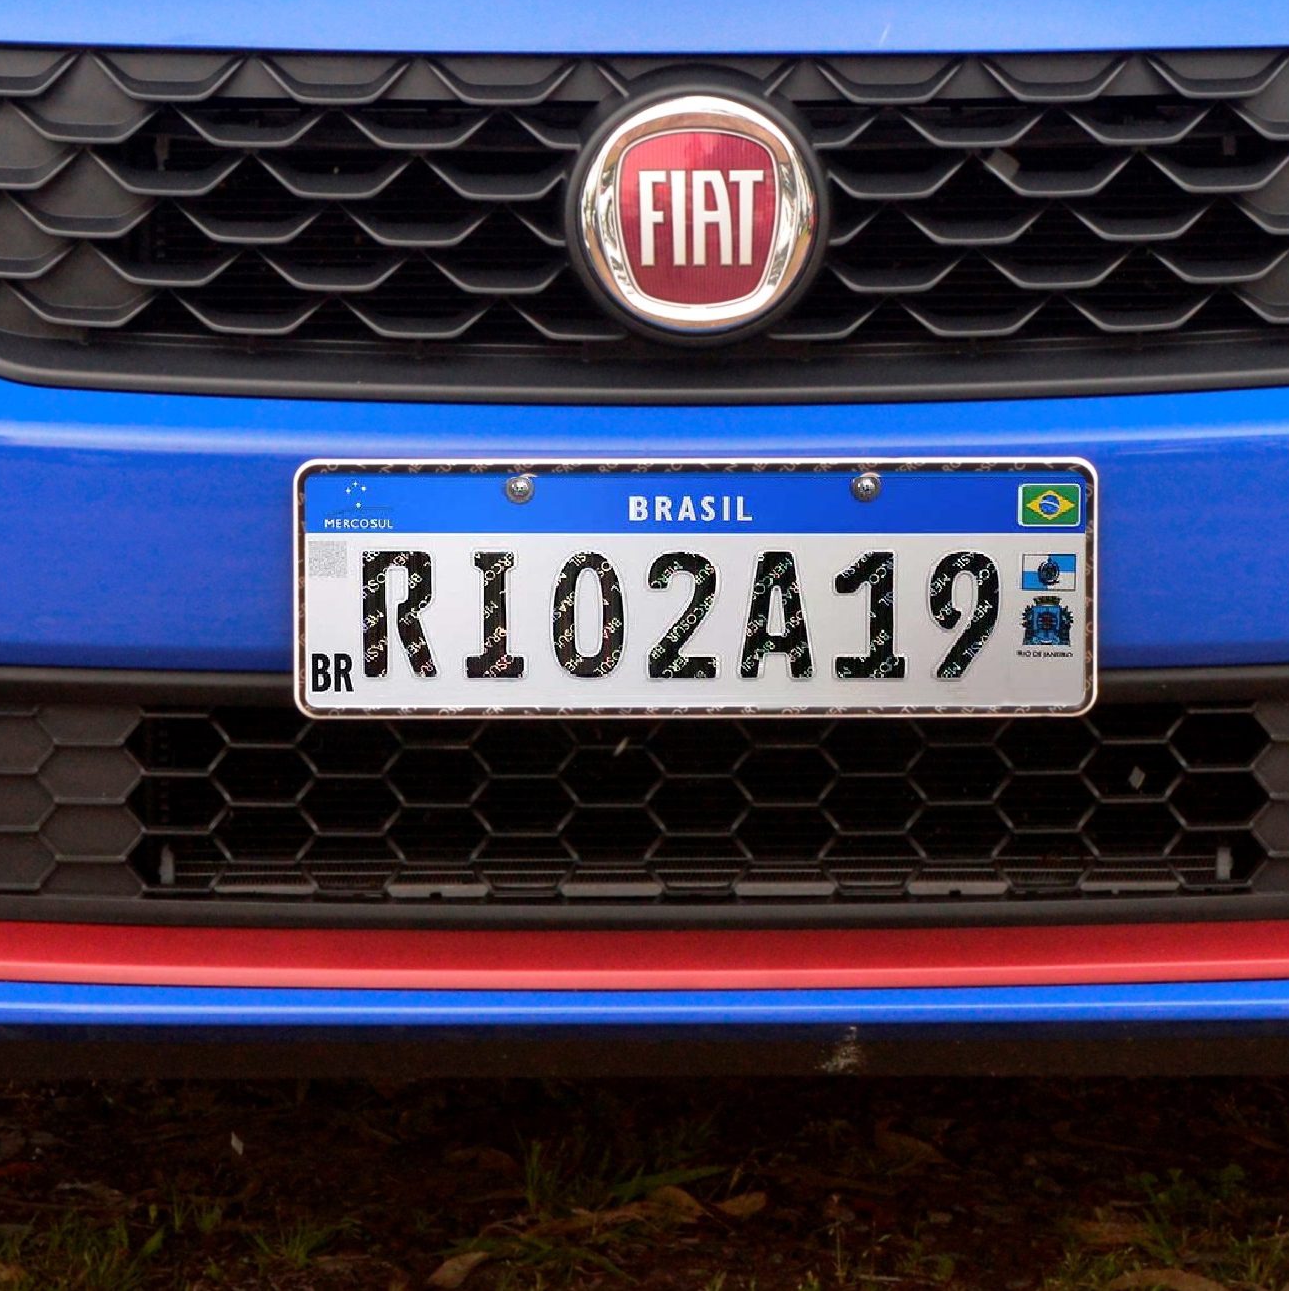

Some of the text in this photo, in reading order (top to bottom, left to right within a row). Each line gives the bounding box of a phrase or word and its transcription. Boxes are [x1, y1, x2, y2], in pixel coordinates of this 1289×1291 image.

[638, 169, 764, 266] FIAT
[324, 518, 394, 529] MERCOSUL
[628, 495, 753, 522] BRASIL
[311, 653, 354, 692] BR
